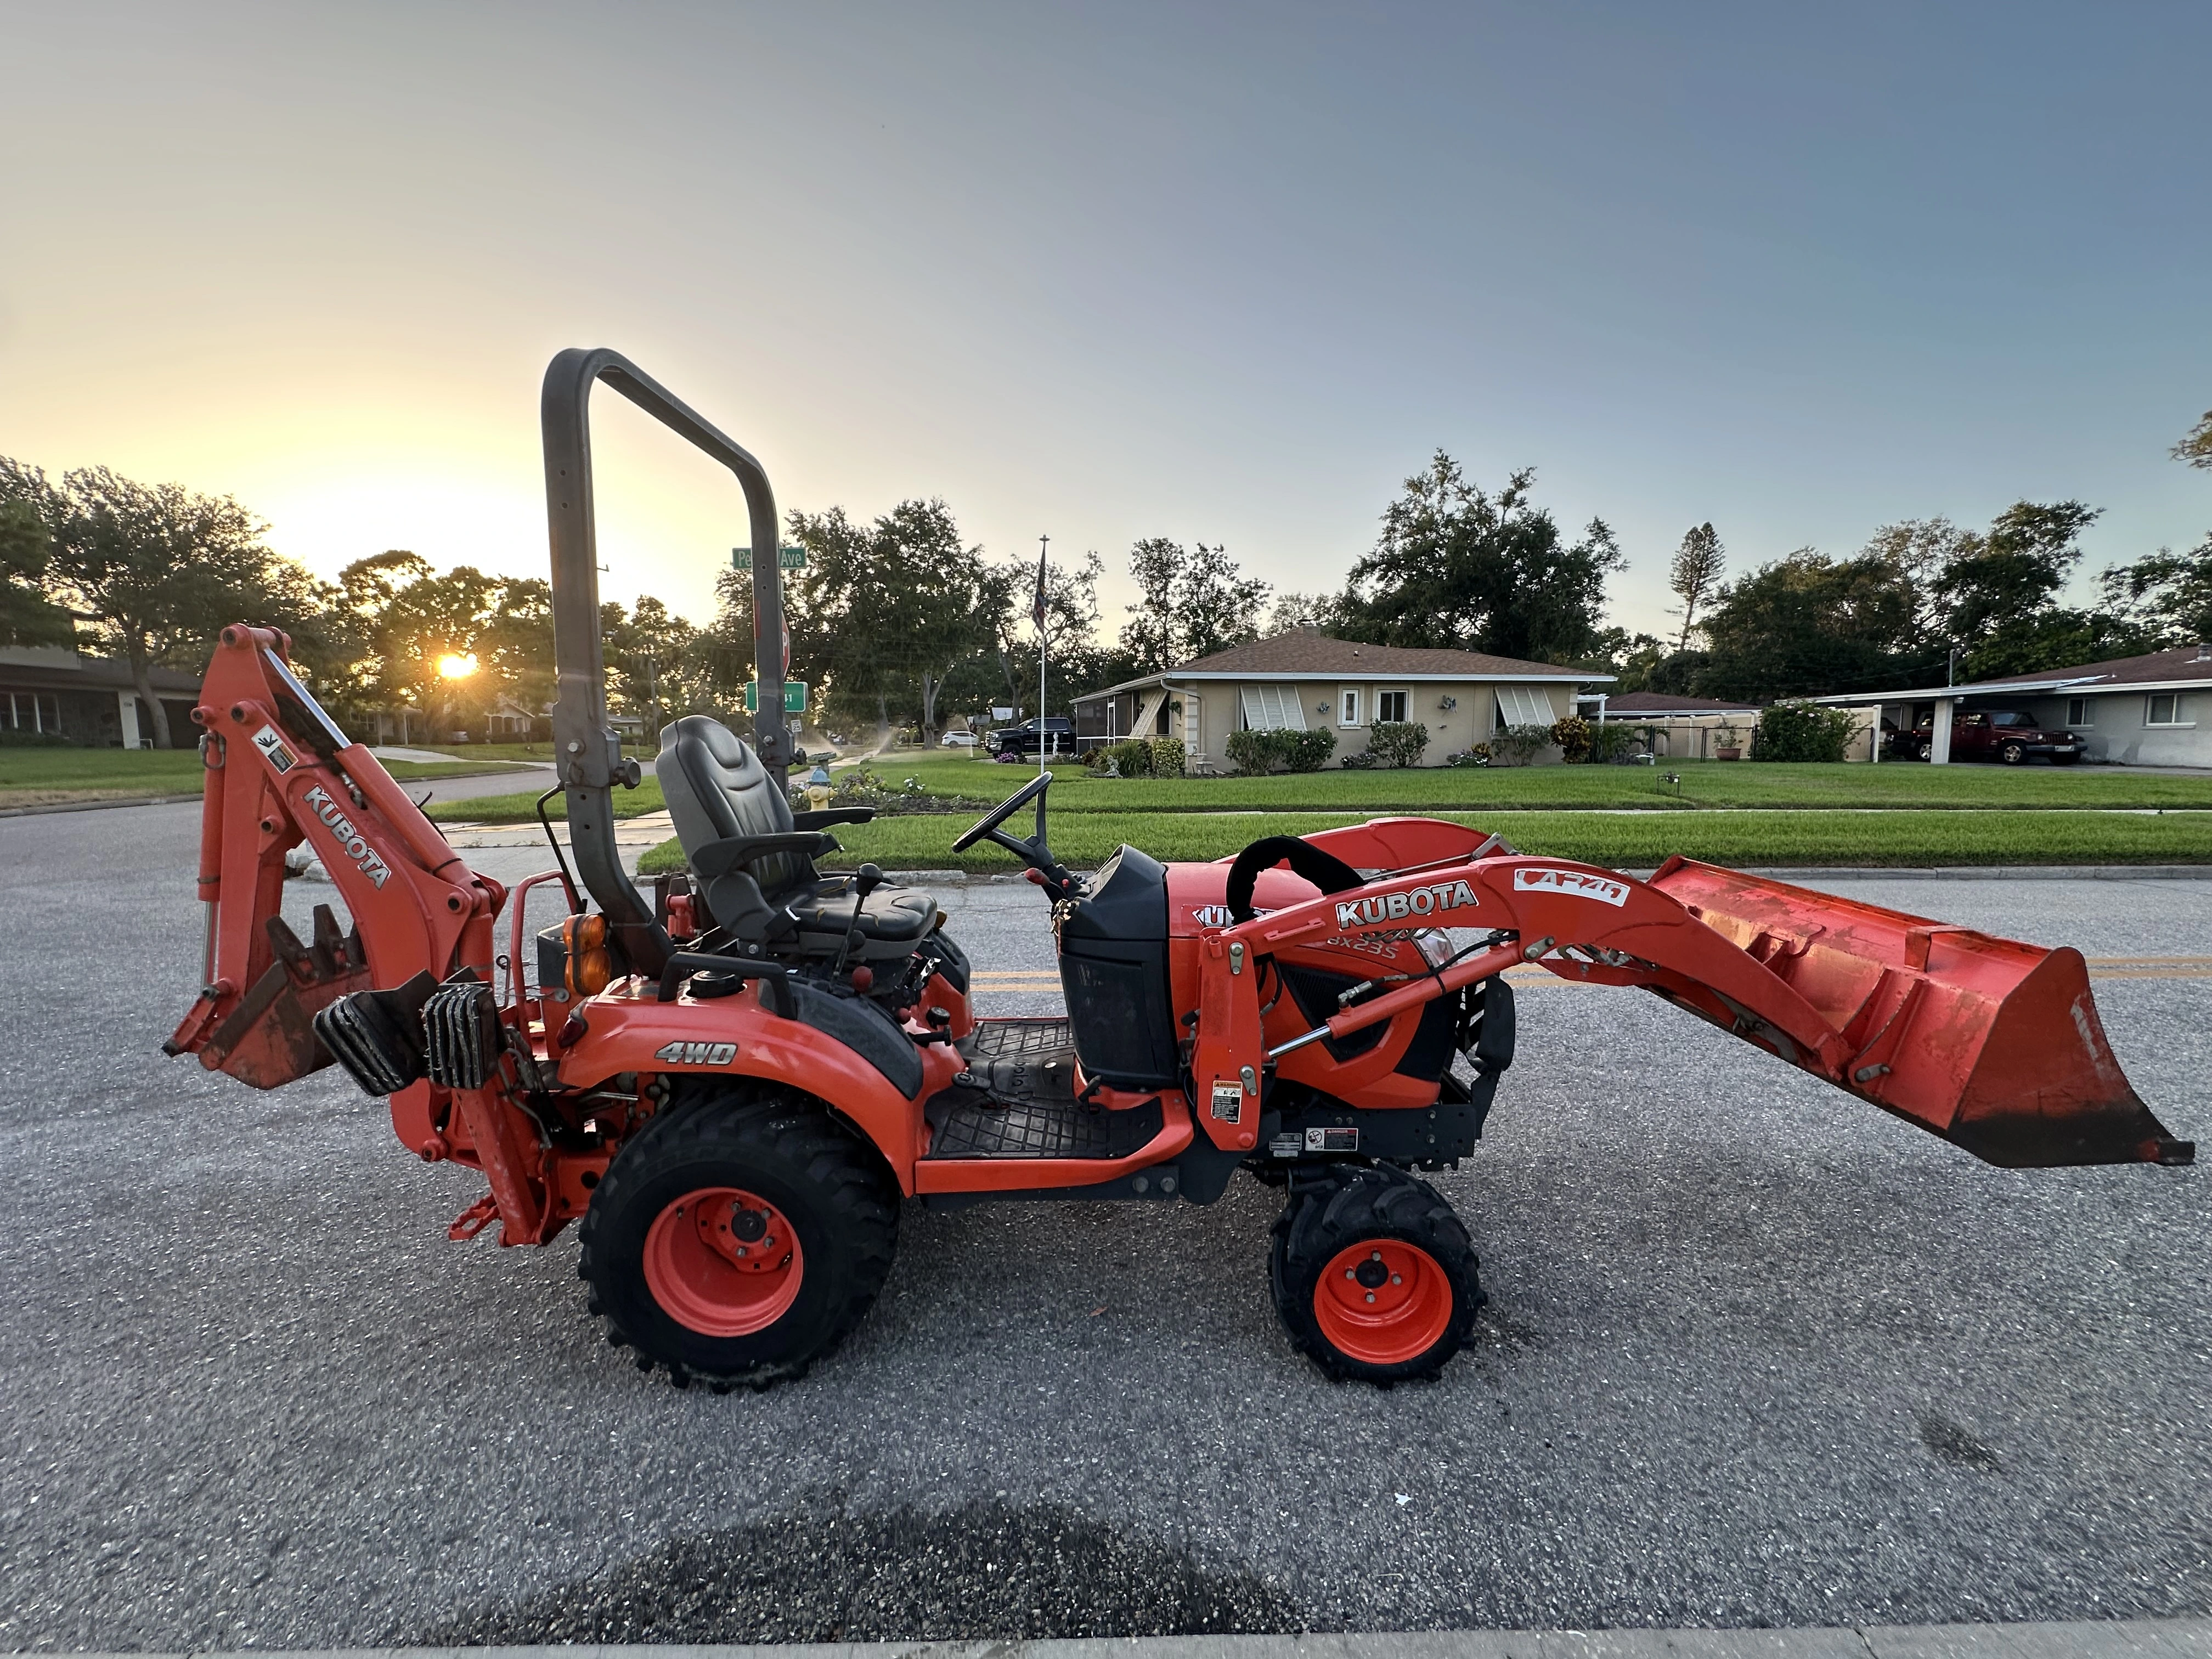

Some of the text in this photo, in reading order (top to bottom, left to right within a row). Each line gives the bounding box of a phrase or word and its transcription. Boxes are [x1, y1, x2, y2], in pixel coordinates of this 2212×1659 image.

[738, 550, 802, 567] Pe Ave
[304, 785, 390, 891] KUBOTA
[1337, 881, 1477, 930] KUBOTA
[654, 1041, 738, 1065] 4WD
